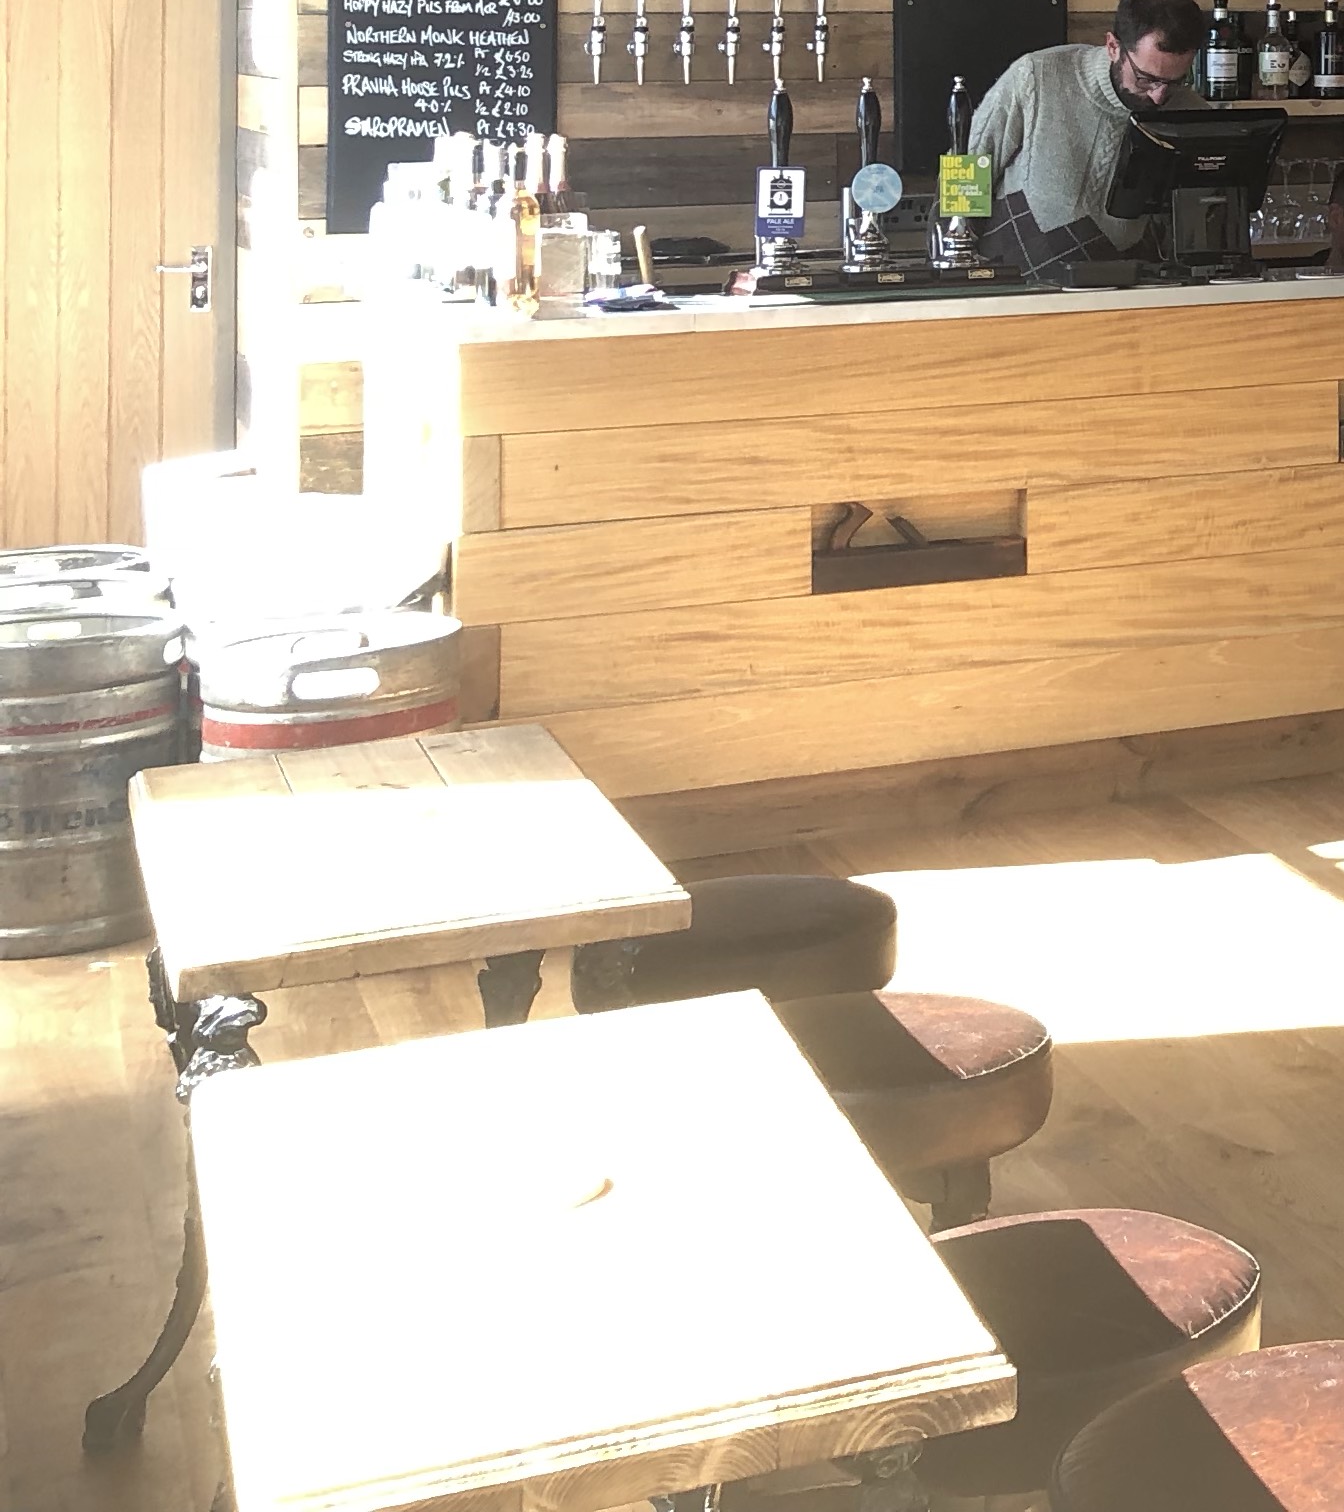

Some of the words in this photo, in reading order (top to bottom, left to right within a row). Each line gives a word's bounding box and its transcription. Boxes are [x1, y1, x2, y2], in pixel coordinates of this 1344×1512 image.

[346, 24, 416, 45] NORTHERN
[421, 25, 465, 46] MONK
[469, 29, 530, 47] HEATHEN
[342, 49, 382, 67] STRONG
[383, 51, 408, 70] HAZY
[341, 73, 399, 97] PRAVHA
[344, 116, 450, 138] STAROPRAMEN
[942, 163, 975, 180] need
